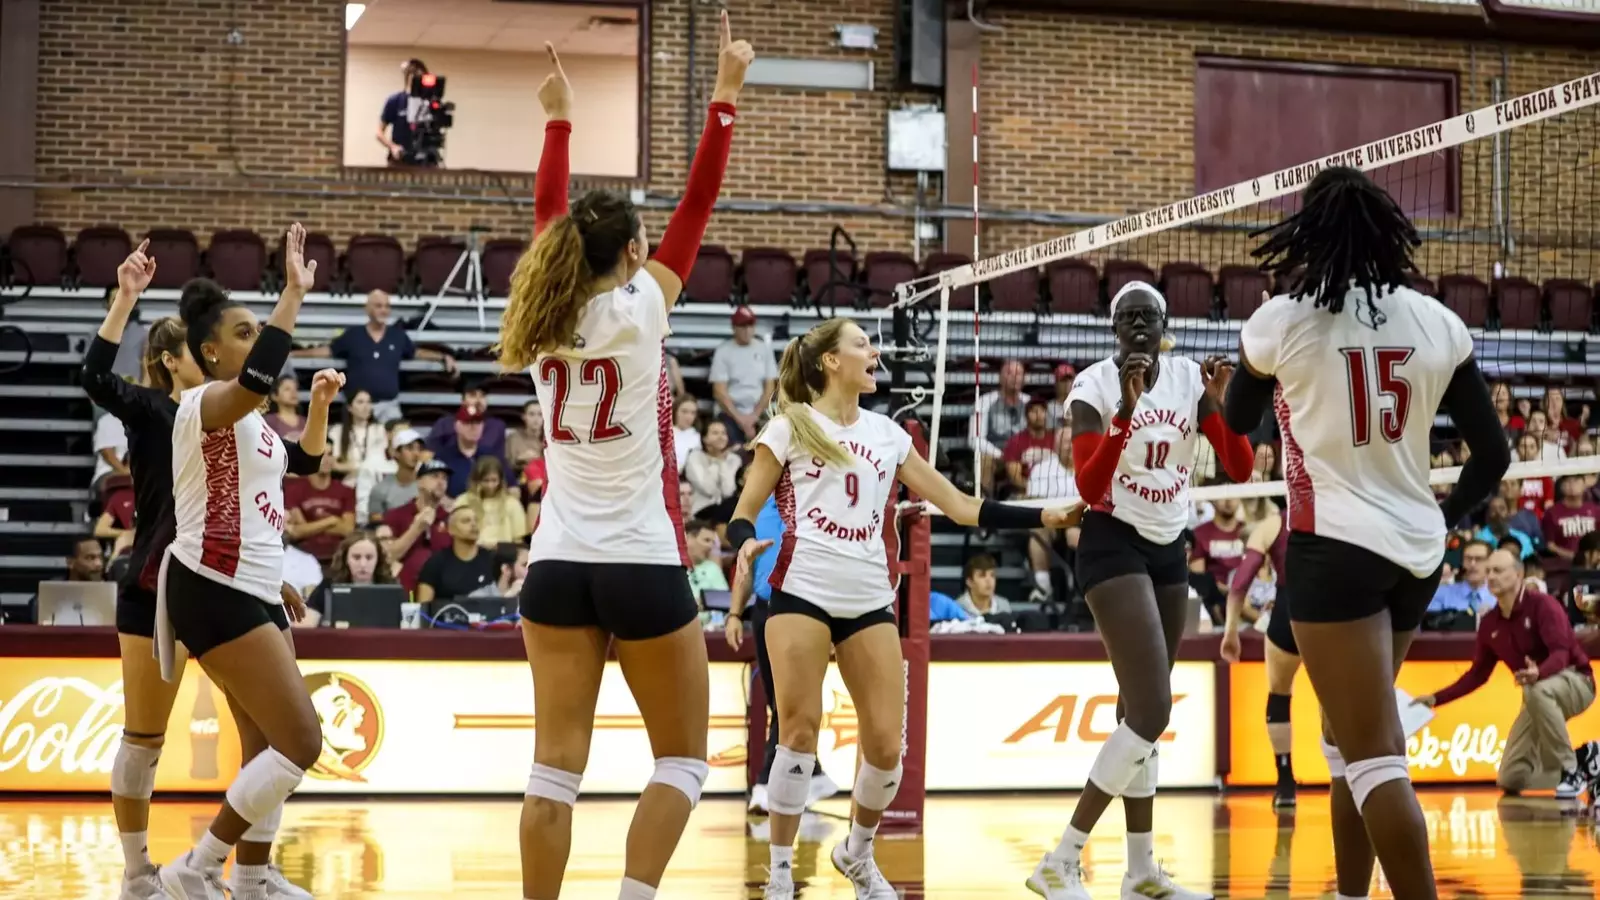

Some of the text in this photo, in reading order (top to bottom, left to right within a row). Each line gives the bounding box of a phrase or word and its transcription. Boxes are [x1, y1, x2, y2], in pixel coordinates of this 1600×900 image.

[1495, 75, 1600, 125] FLORIDA STAT
[1274, 161, 1321, 190] FLORIDA
[1367, 123, 1443, 163] UNIVERSITY
[1106, 187, 1235, 240] FLORIDA STATE UNIVERSITY
[1005, 248, 1028, 268] STATE
[1031, 235, 1077, 260] UNIVERSITY
[540, 356, 632, 445] 22
[1338, 346, 1415, 447] 15
[805, 441, 886, 482] LOVILLE
[1145, 441, 1170, 470] 10
[845, 473, 859, 508] 9
[1118, 464, 1188, 504] CARDINALS
